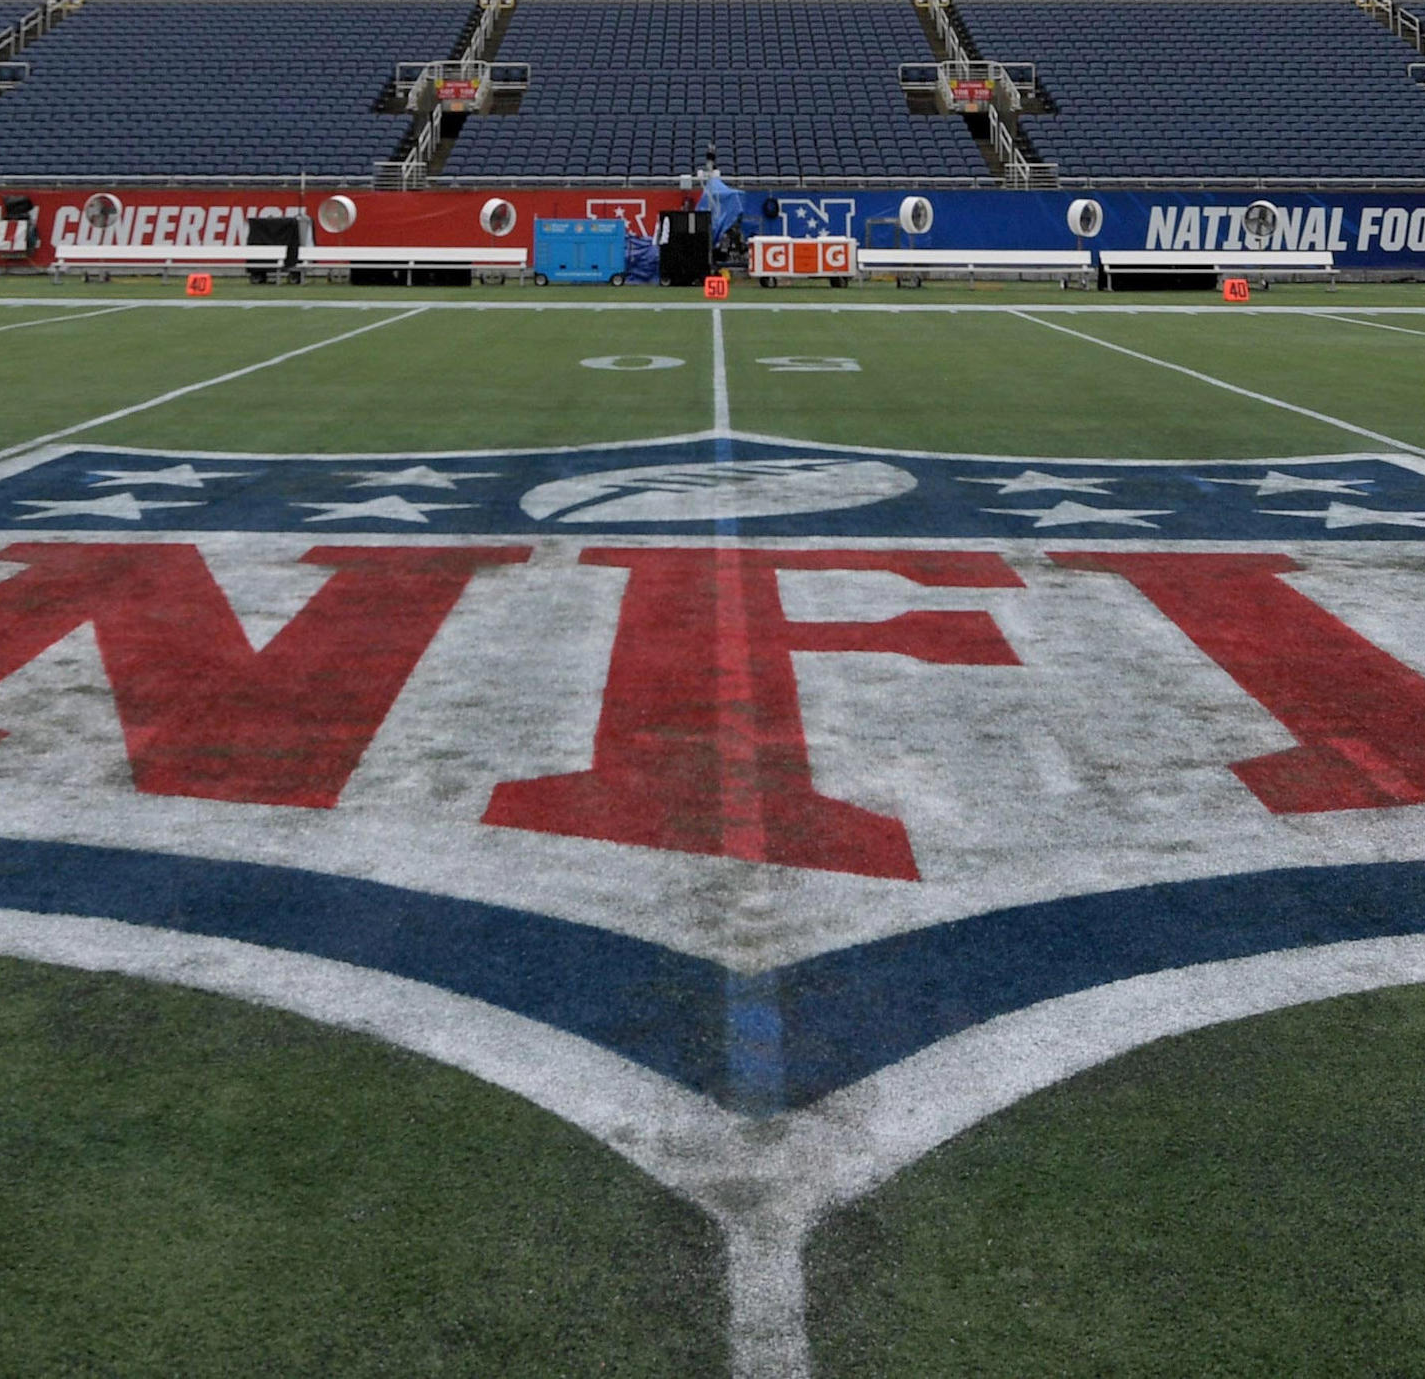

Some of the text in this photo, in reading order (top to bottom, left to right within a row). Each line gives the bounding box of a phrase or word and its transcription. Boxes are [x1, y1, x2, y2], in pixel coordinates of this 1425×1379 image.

[50, 205, 308, 248] CONFEREN
[1145, 206, 1347, 251] NATINAL
[766, 245, 786, 268] G
[825, 245, 846, 268] G
[707, 279, 725, 296] 50
[1229, 281, 1247, 299] 40
